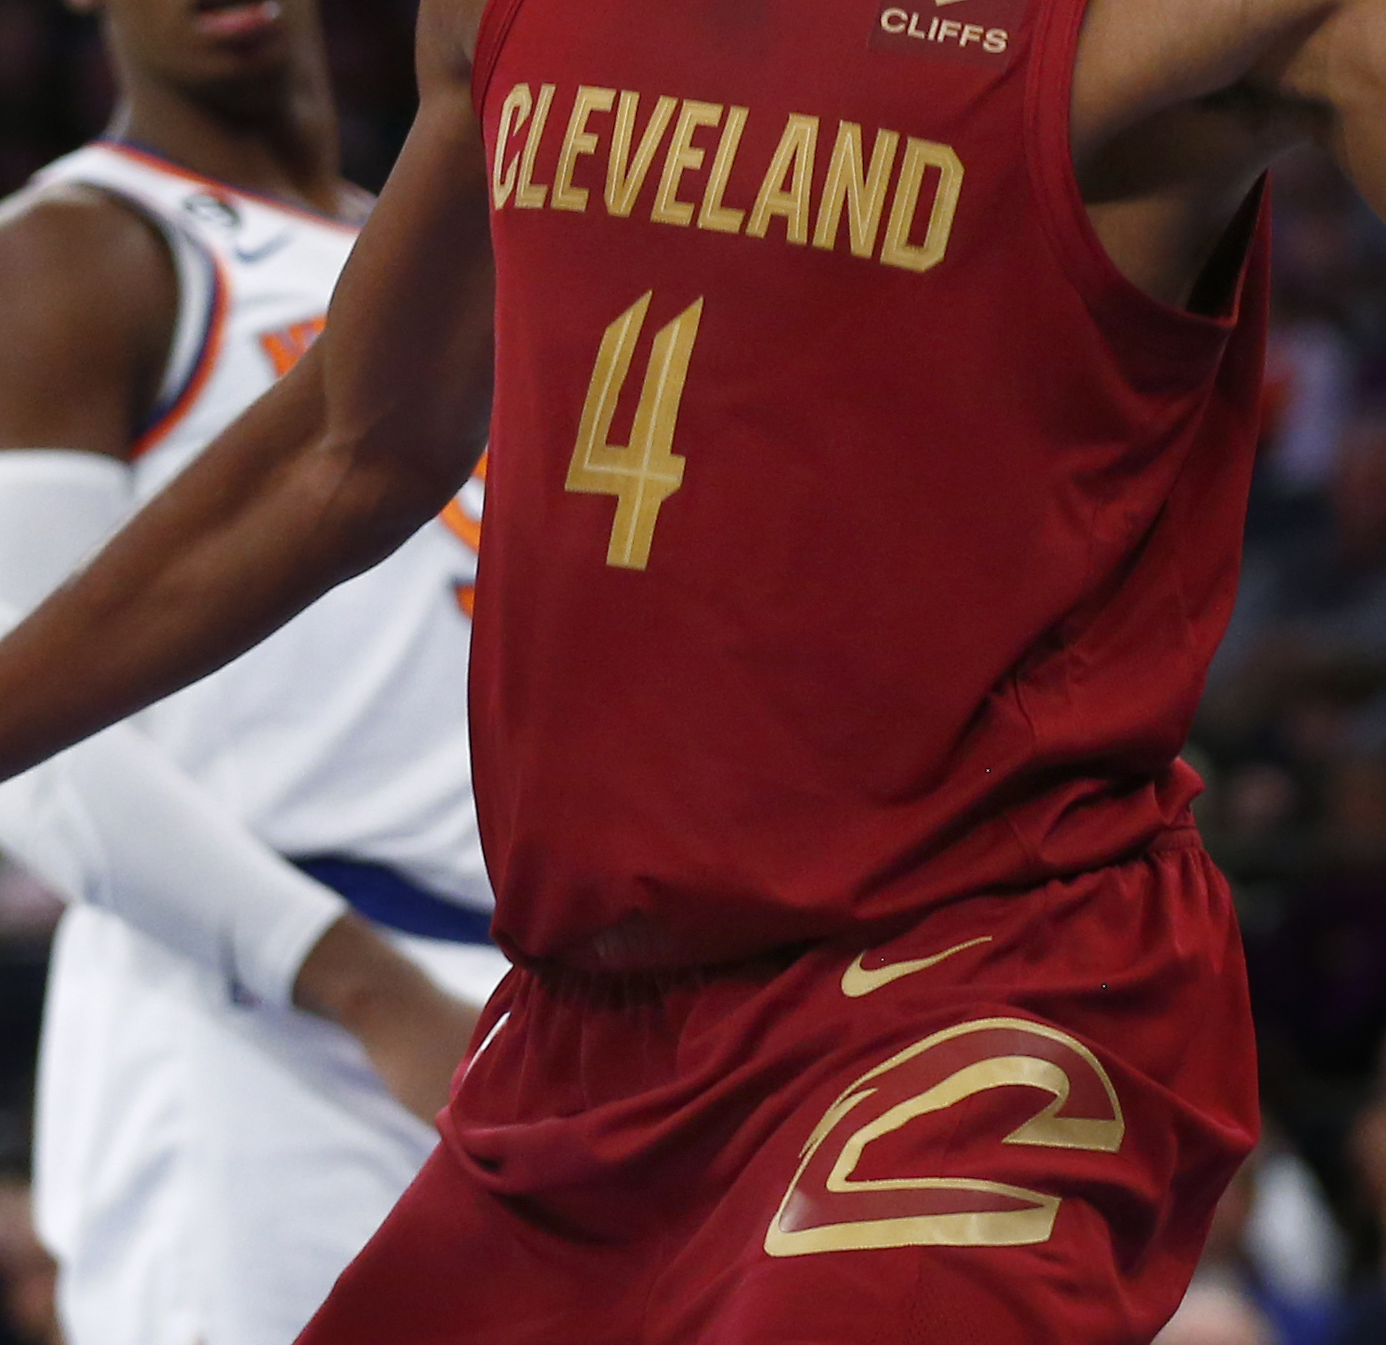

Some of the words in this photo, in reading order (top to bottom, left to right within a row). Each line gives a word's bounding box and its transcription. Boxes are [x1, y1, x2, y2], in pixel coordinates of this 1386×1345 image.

[880, 6, 1010, 55] CLIFFS
[491, 81, 965, 274] CLEVELAND
[564, 289, 704, 571] 4
